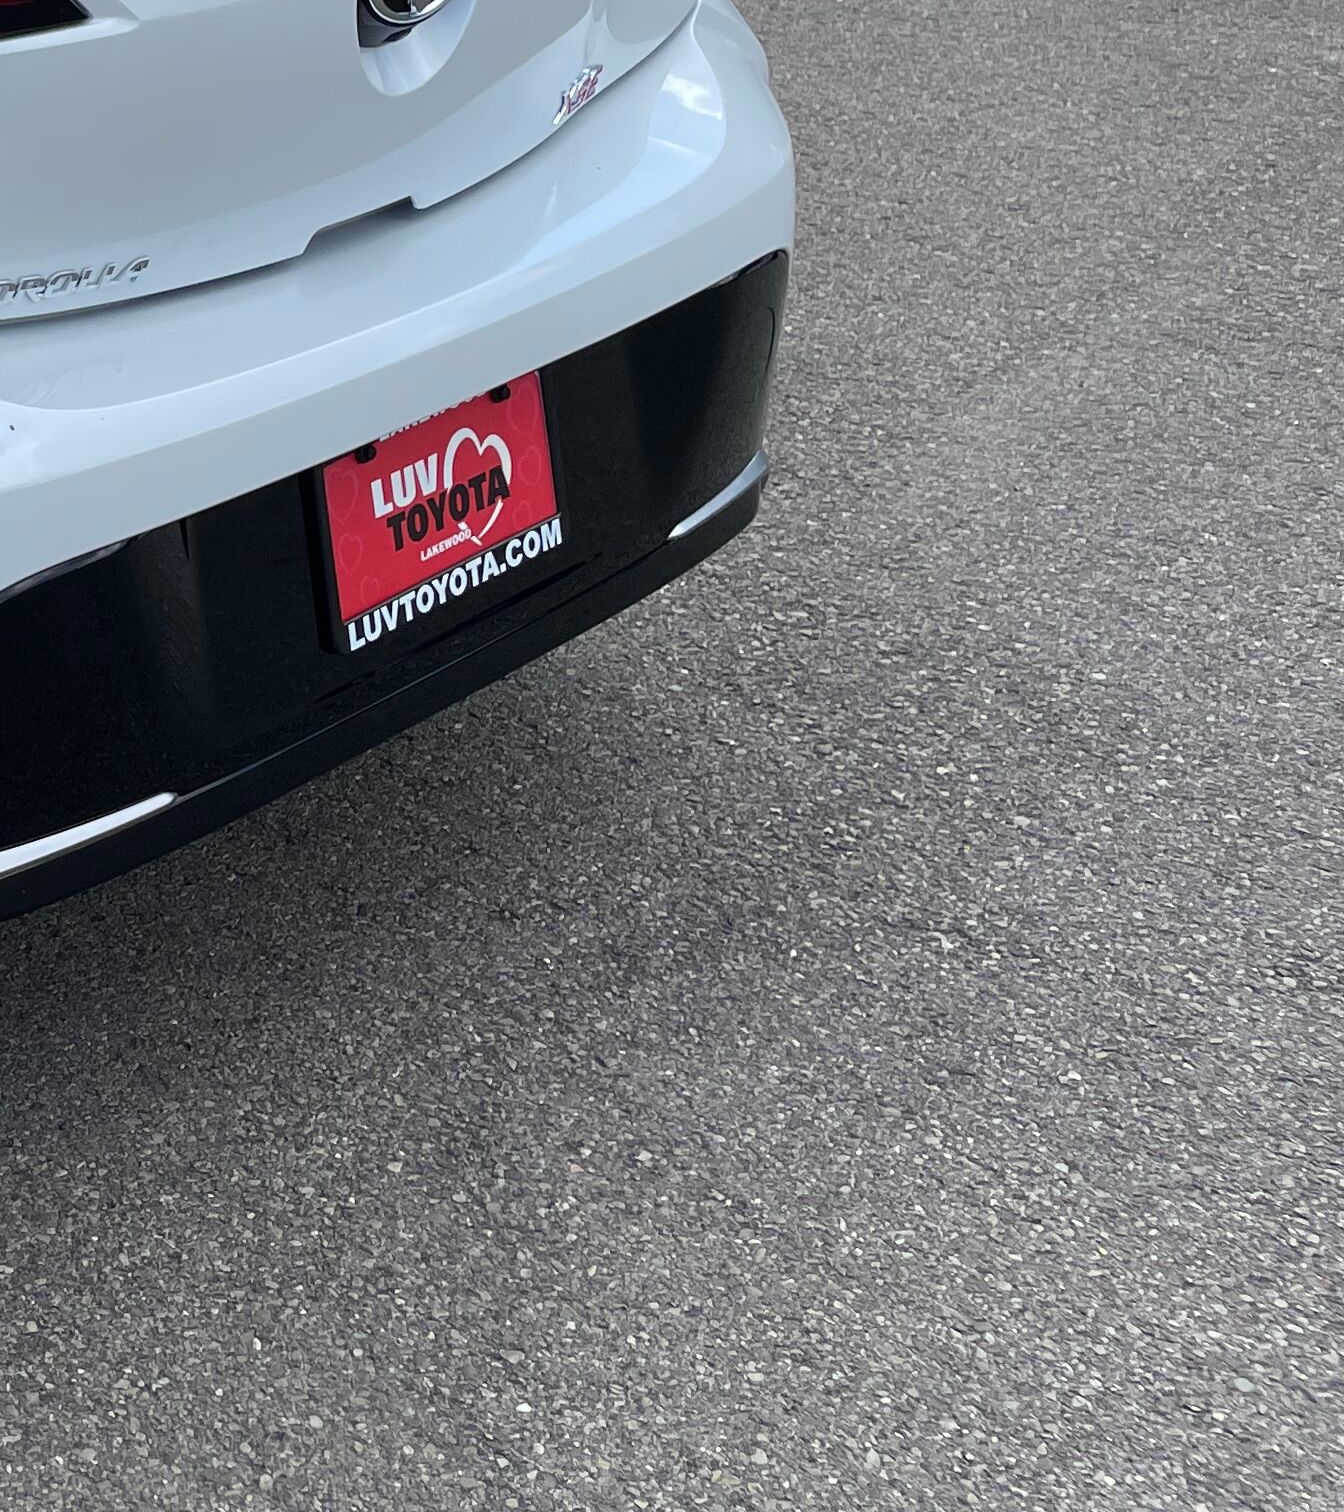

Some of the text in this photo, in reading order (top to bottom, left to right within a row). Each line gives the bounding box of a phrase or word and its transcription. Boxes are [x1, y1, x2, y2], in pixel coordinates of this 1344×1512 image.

[370, 452, 438, 519] LUV
[386, 465, 511, 552] TOYOTA
[420, 528, 473, 562] LAKEWOOD
[347, 518, 563, 652] LUVTOYOTA.COM
